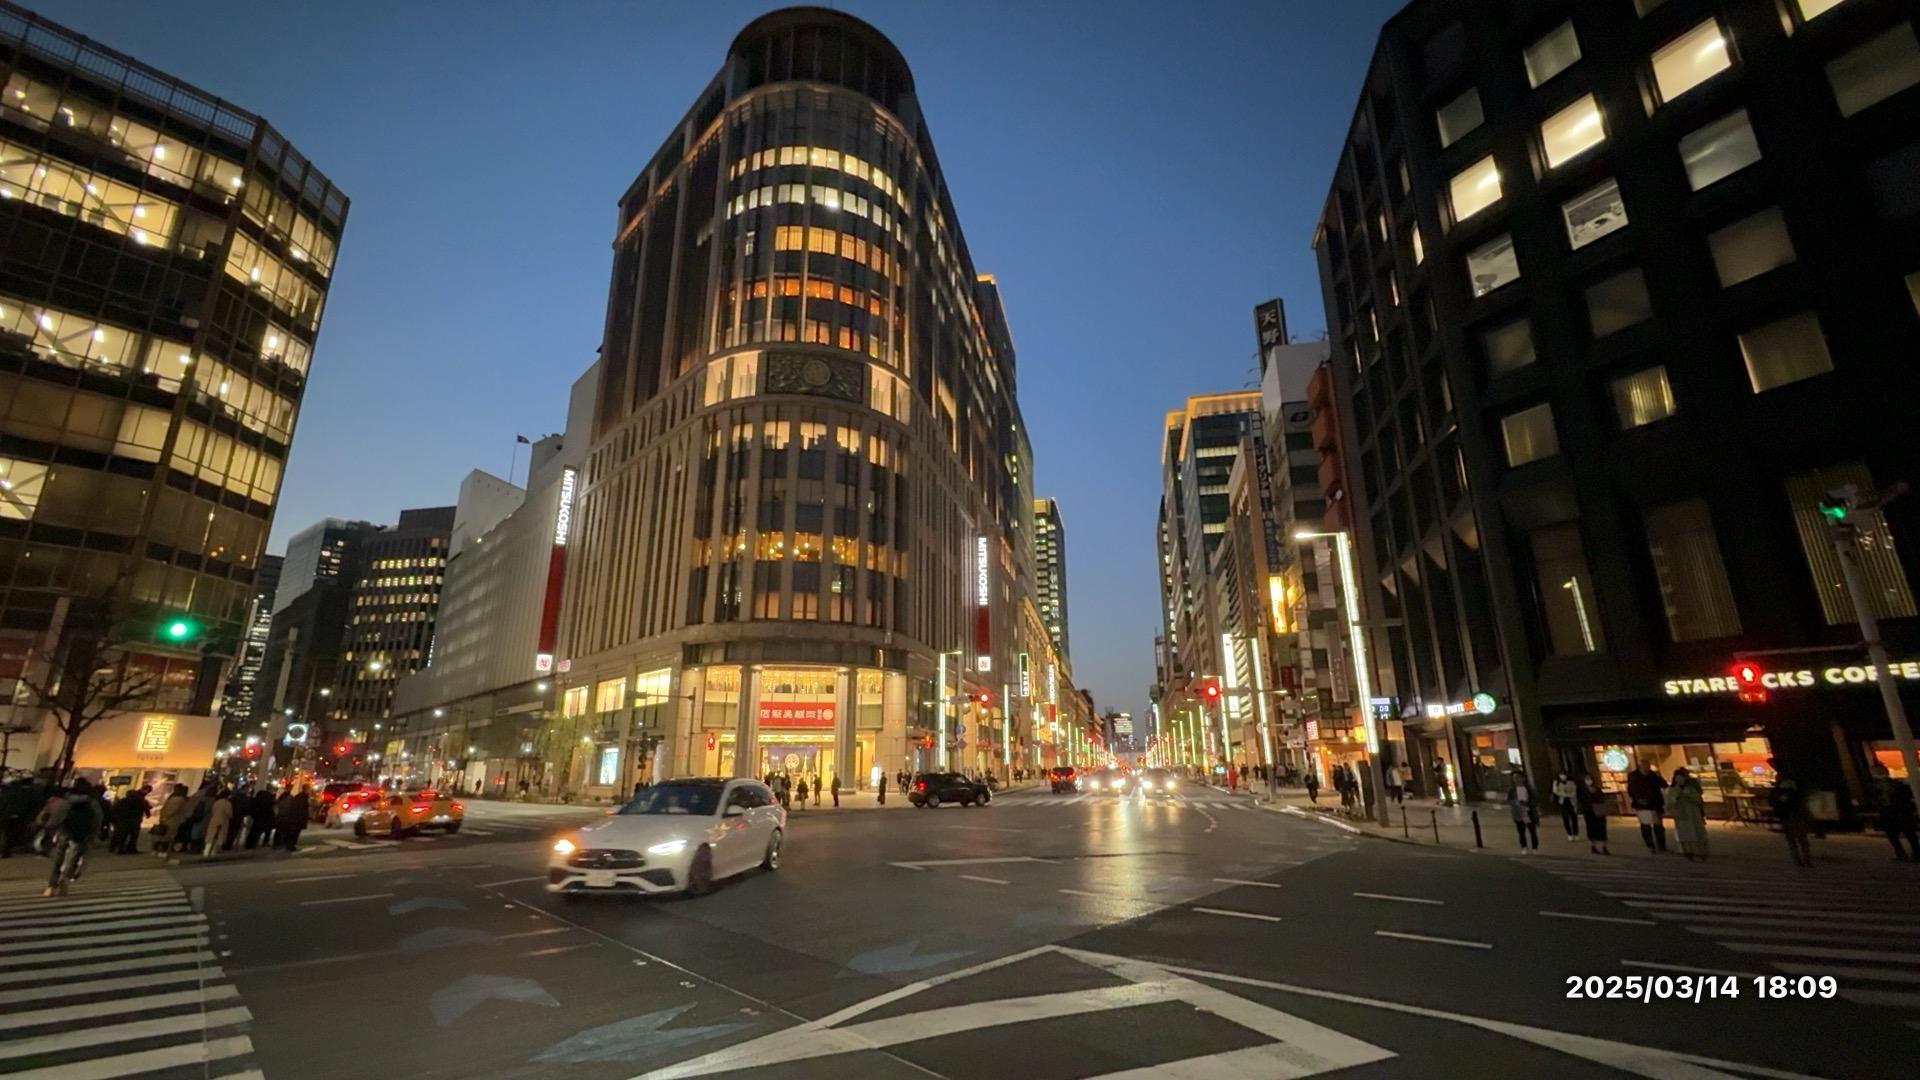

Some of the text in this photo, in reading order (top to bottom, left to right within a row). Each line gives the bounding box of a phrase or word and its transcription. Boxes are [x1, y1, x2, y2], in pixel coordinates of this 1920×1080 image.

[555, 469, 575, 545] MITSUKOSHI
[978, 537, 988, 606] MITSUKOSHI
[1664, 670, 1815, 695] STARBCKS
